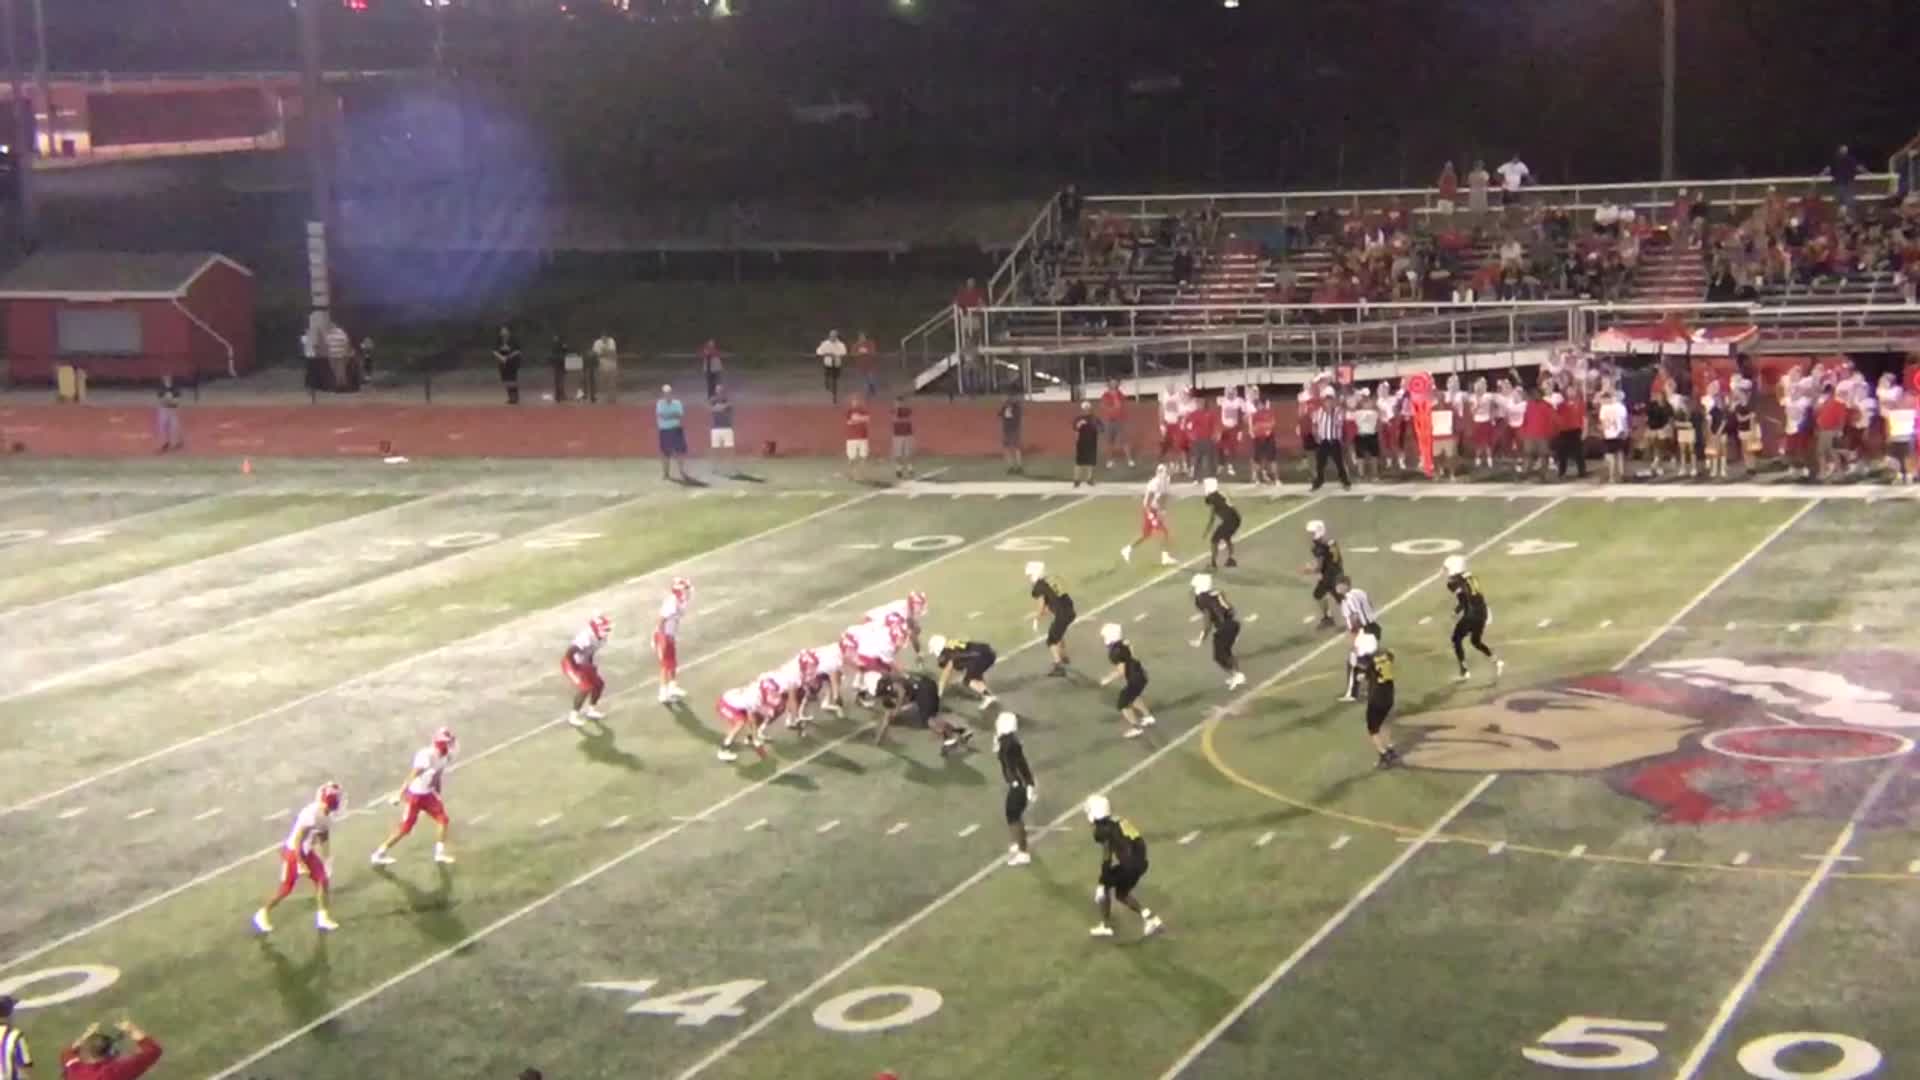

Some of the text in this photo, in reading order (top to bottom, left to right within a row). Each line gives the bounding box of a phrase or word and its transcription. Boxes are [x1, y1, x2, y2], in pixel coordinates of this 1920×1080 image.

[893, 534, 1070, 551] 30
[1391, 538, 1579, 555] 40
[625, 979, 943, 1031] 40
[1521, 1016, 1883, 1080] 50
